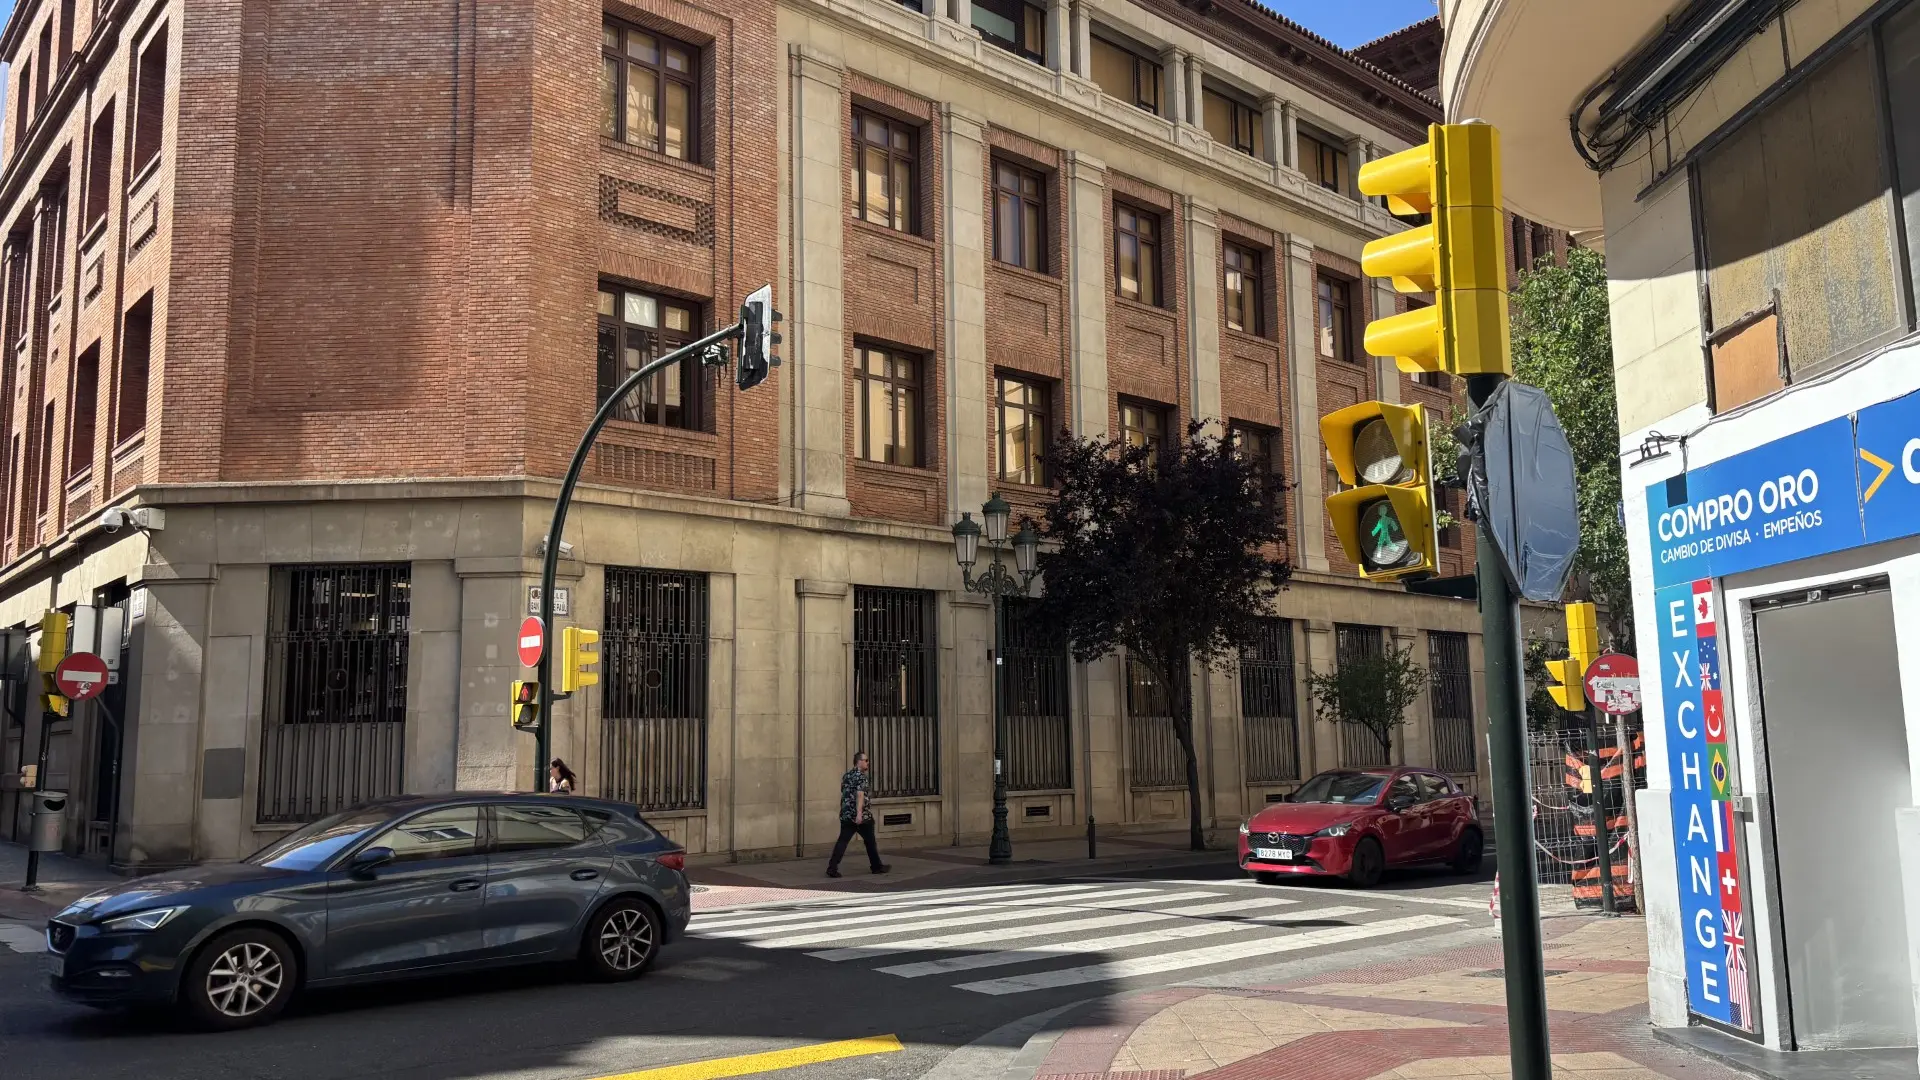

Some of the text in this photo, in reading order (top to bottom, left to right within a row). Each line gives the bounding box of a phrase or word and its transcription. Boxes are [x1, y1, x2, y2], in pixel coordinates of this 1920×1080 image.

[1657, 468, 1819, 542] COMPRO ORO
[1660, 510, 1823, 564] CAMBIO DE DIVISA EMPEÑOS
[1669, 599, 1721, 1004] EXCHANGE
[1260, 849, 1276, 858] 8278
